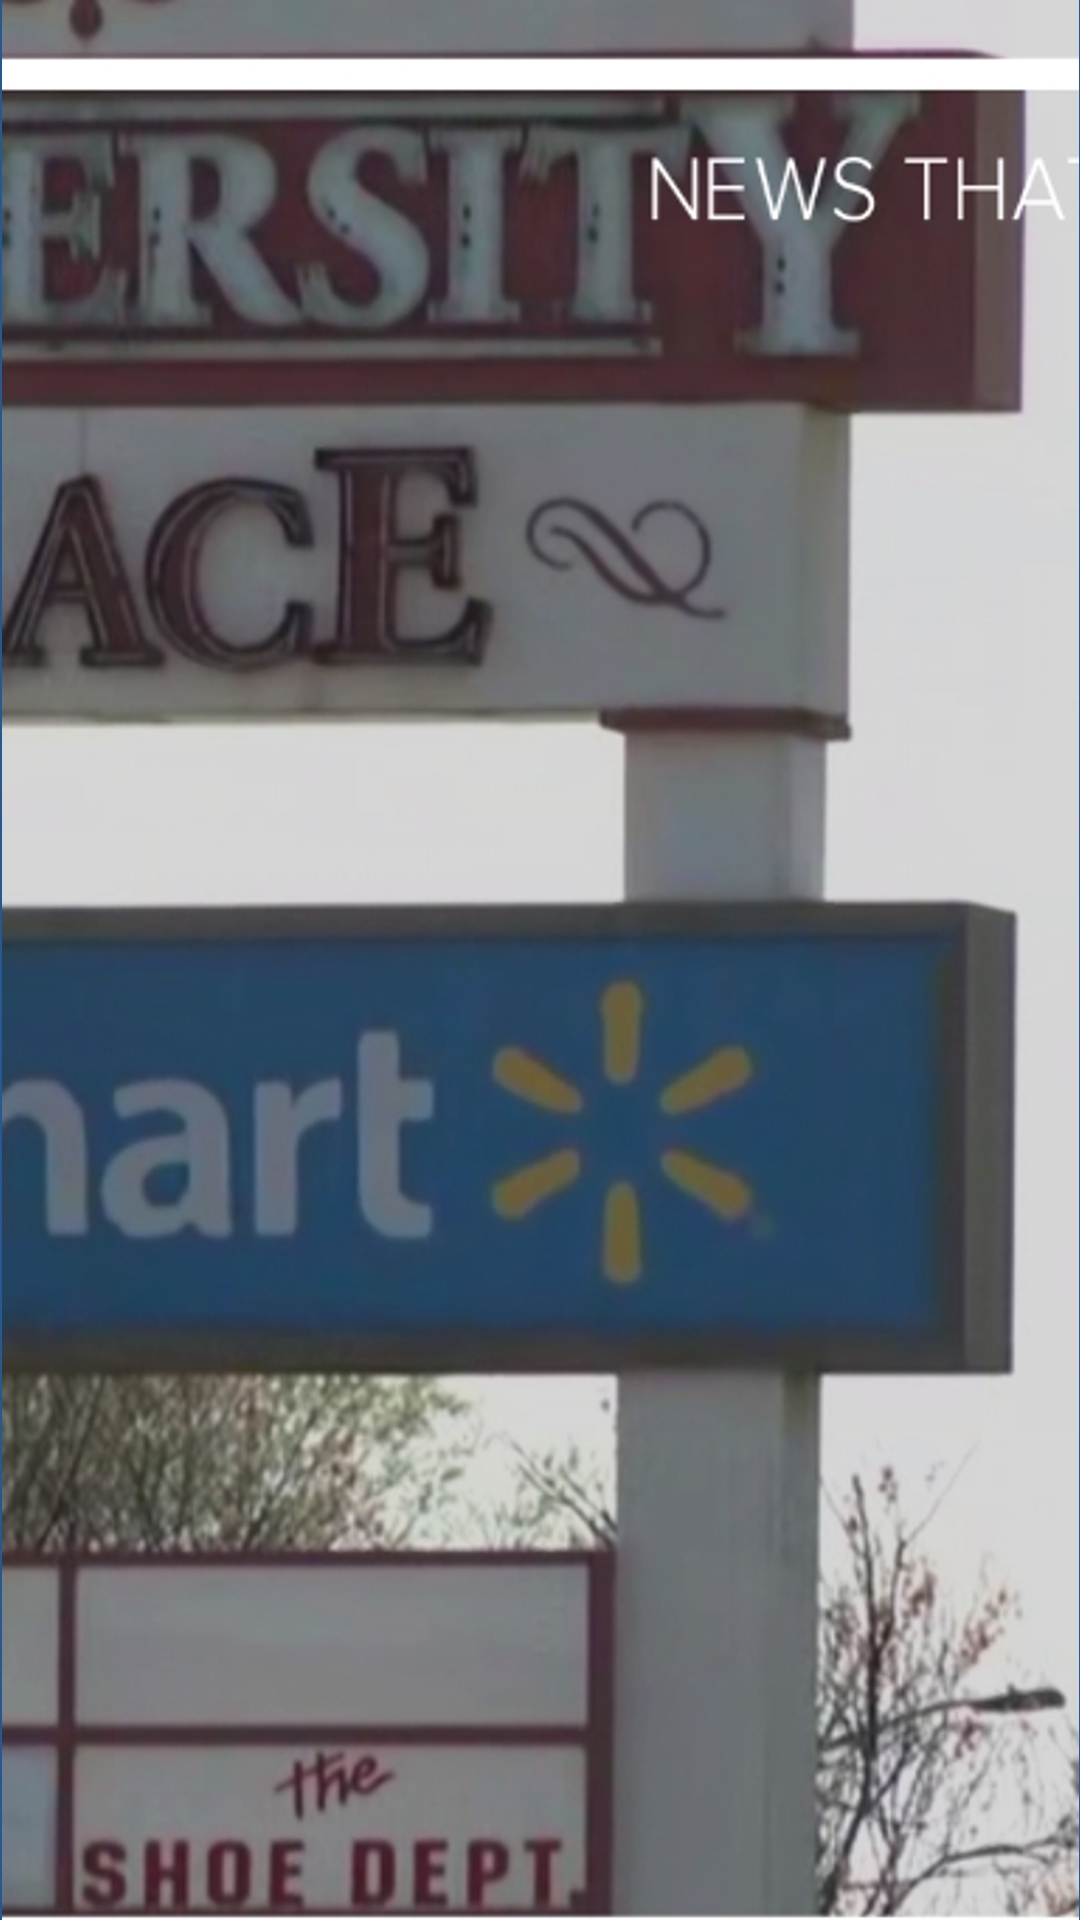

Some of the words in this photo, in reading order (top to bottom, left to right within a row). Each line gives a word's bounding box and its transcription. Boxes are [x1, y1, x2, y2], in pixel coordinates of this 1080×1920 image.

[2, 447, 493, 671] ACE
[276, 1750, 395, 1820] the
[82, 1839, 306, 1909] SHOE
